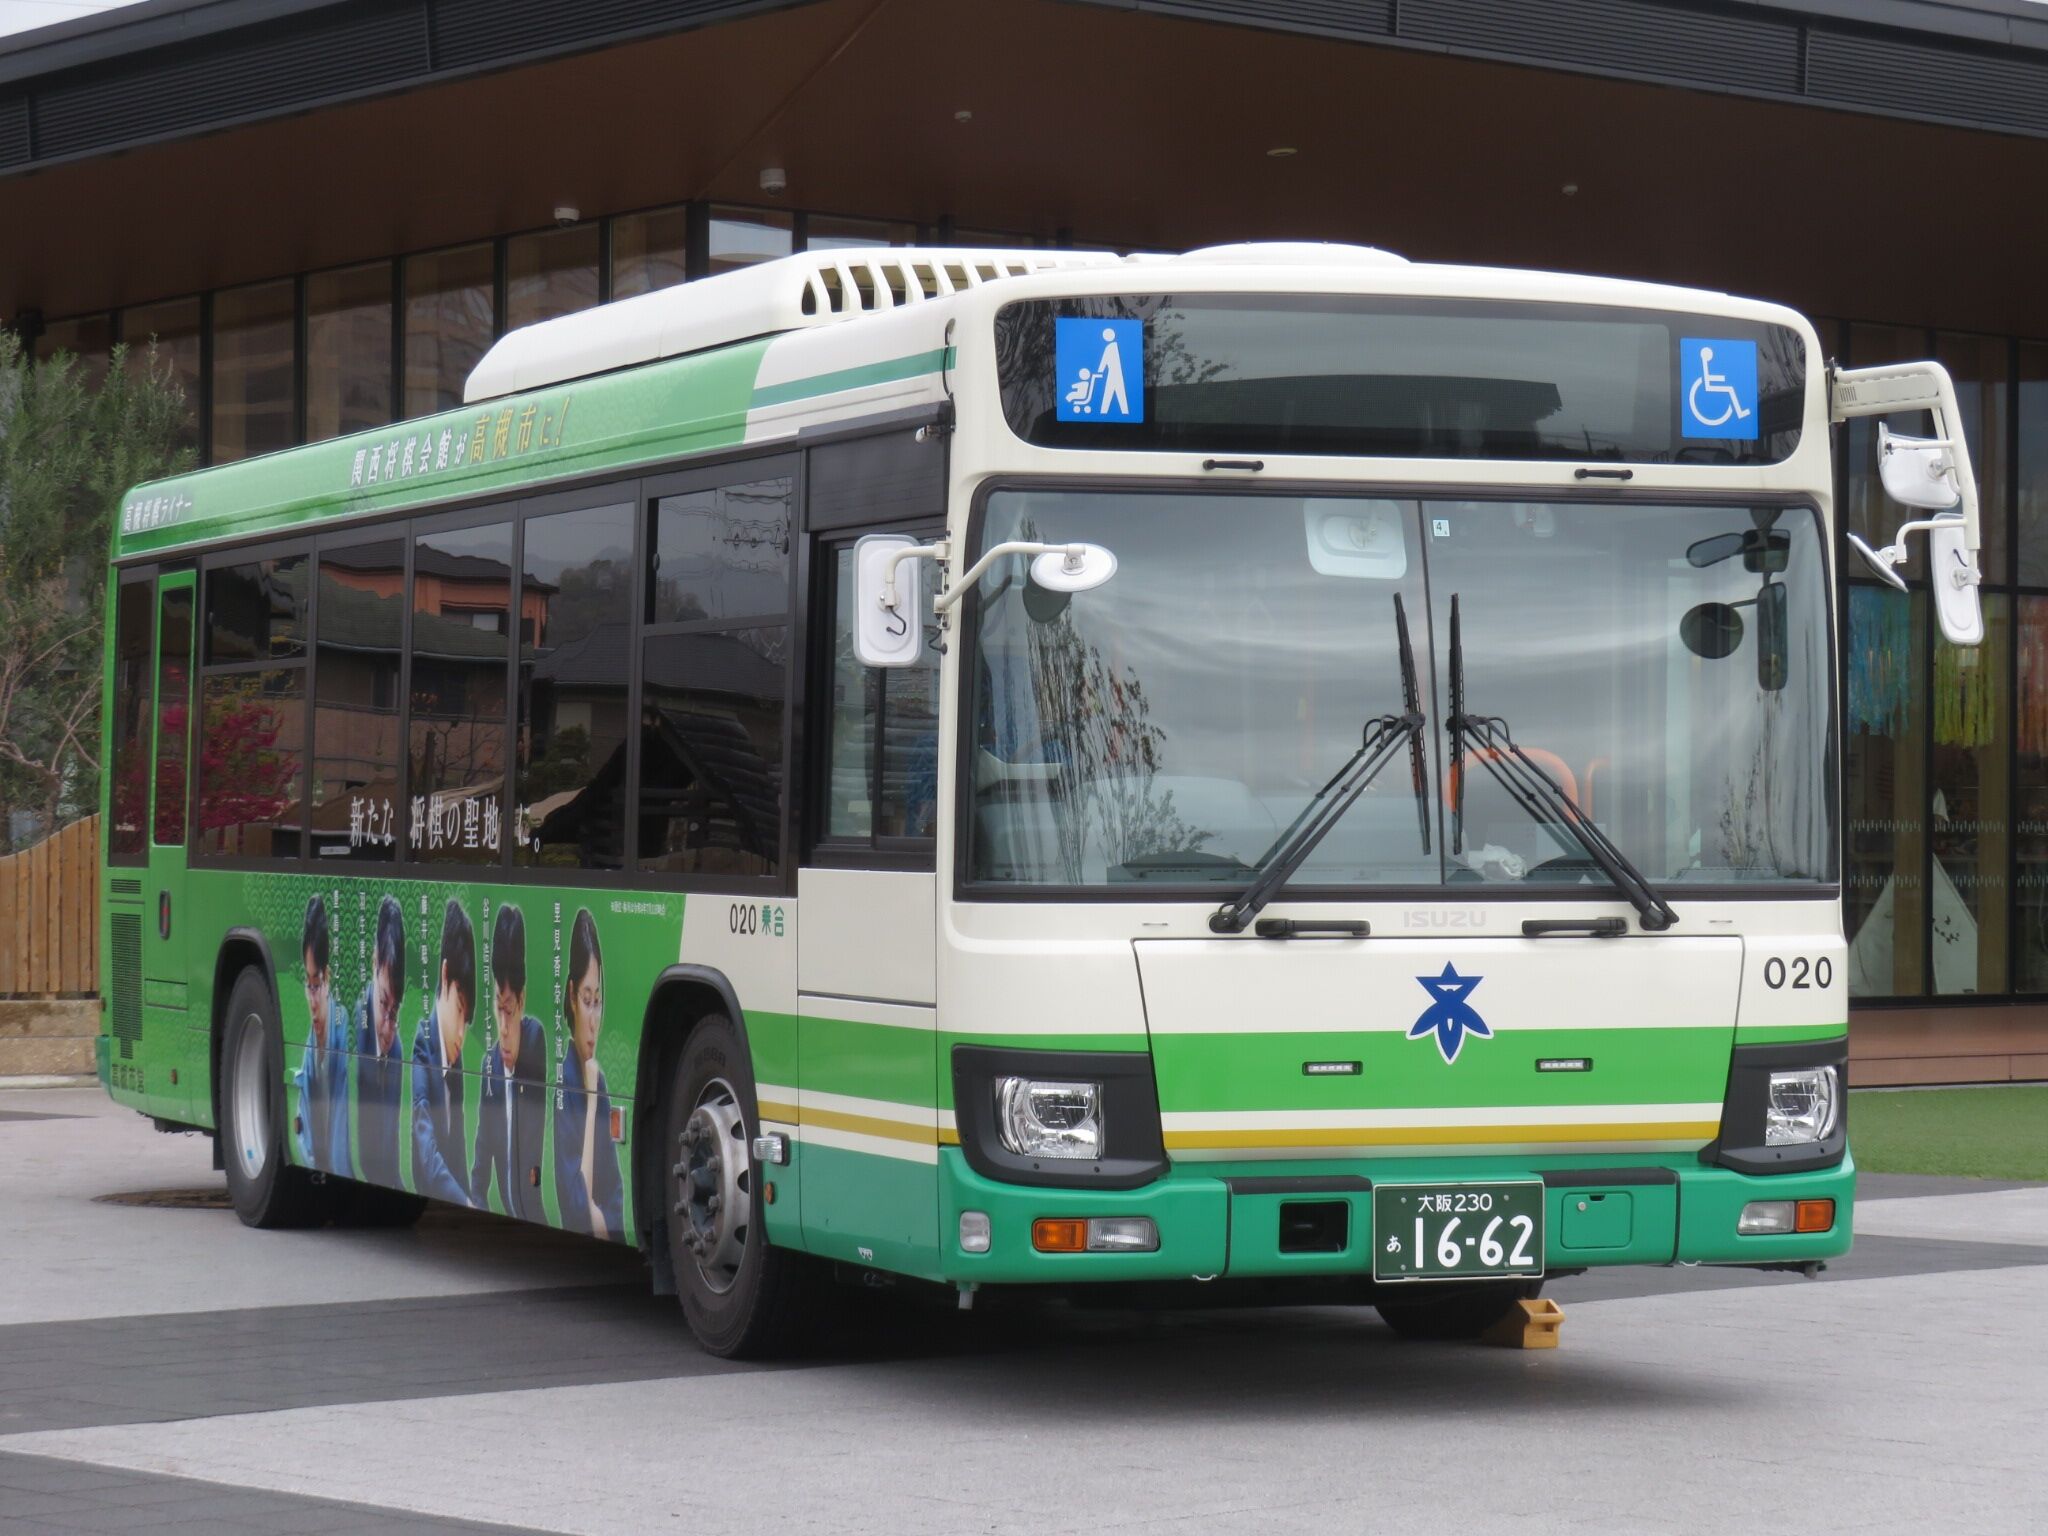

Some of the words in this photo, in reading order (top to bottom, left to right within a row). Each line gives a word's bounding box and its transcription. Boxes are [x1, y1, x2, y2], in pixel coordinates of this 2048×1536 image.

[350, 396, 571, 486] 関西将棋会館が高槻市に!
[730, 903, 757, 935] 020
[762, 905, 784, 937] 乗合
[1403, 910, 1487, 928] ISUZU
[1763, 956, 1832, 990] 020
[552, 902, 565, 1110] 里見香奈女流四冠
[1386, 1235, 1402, 1253] あ
[1415, 1215, 1534, 1269] 16-62
